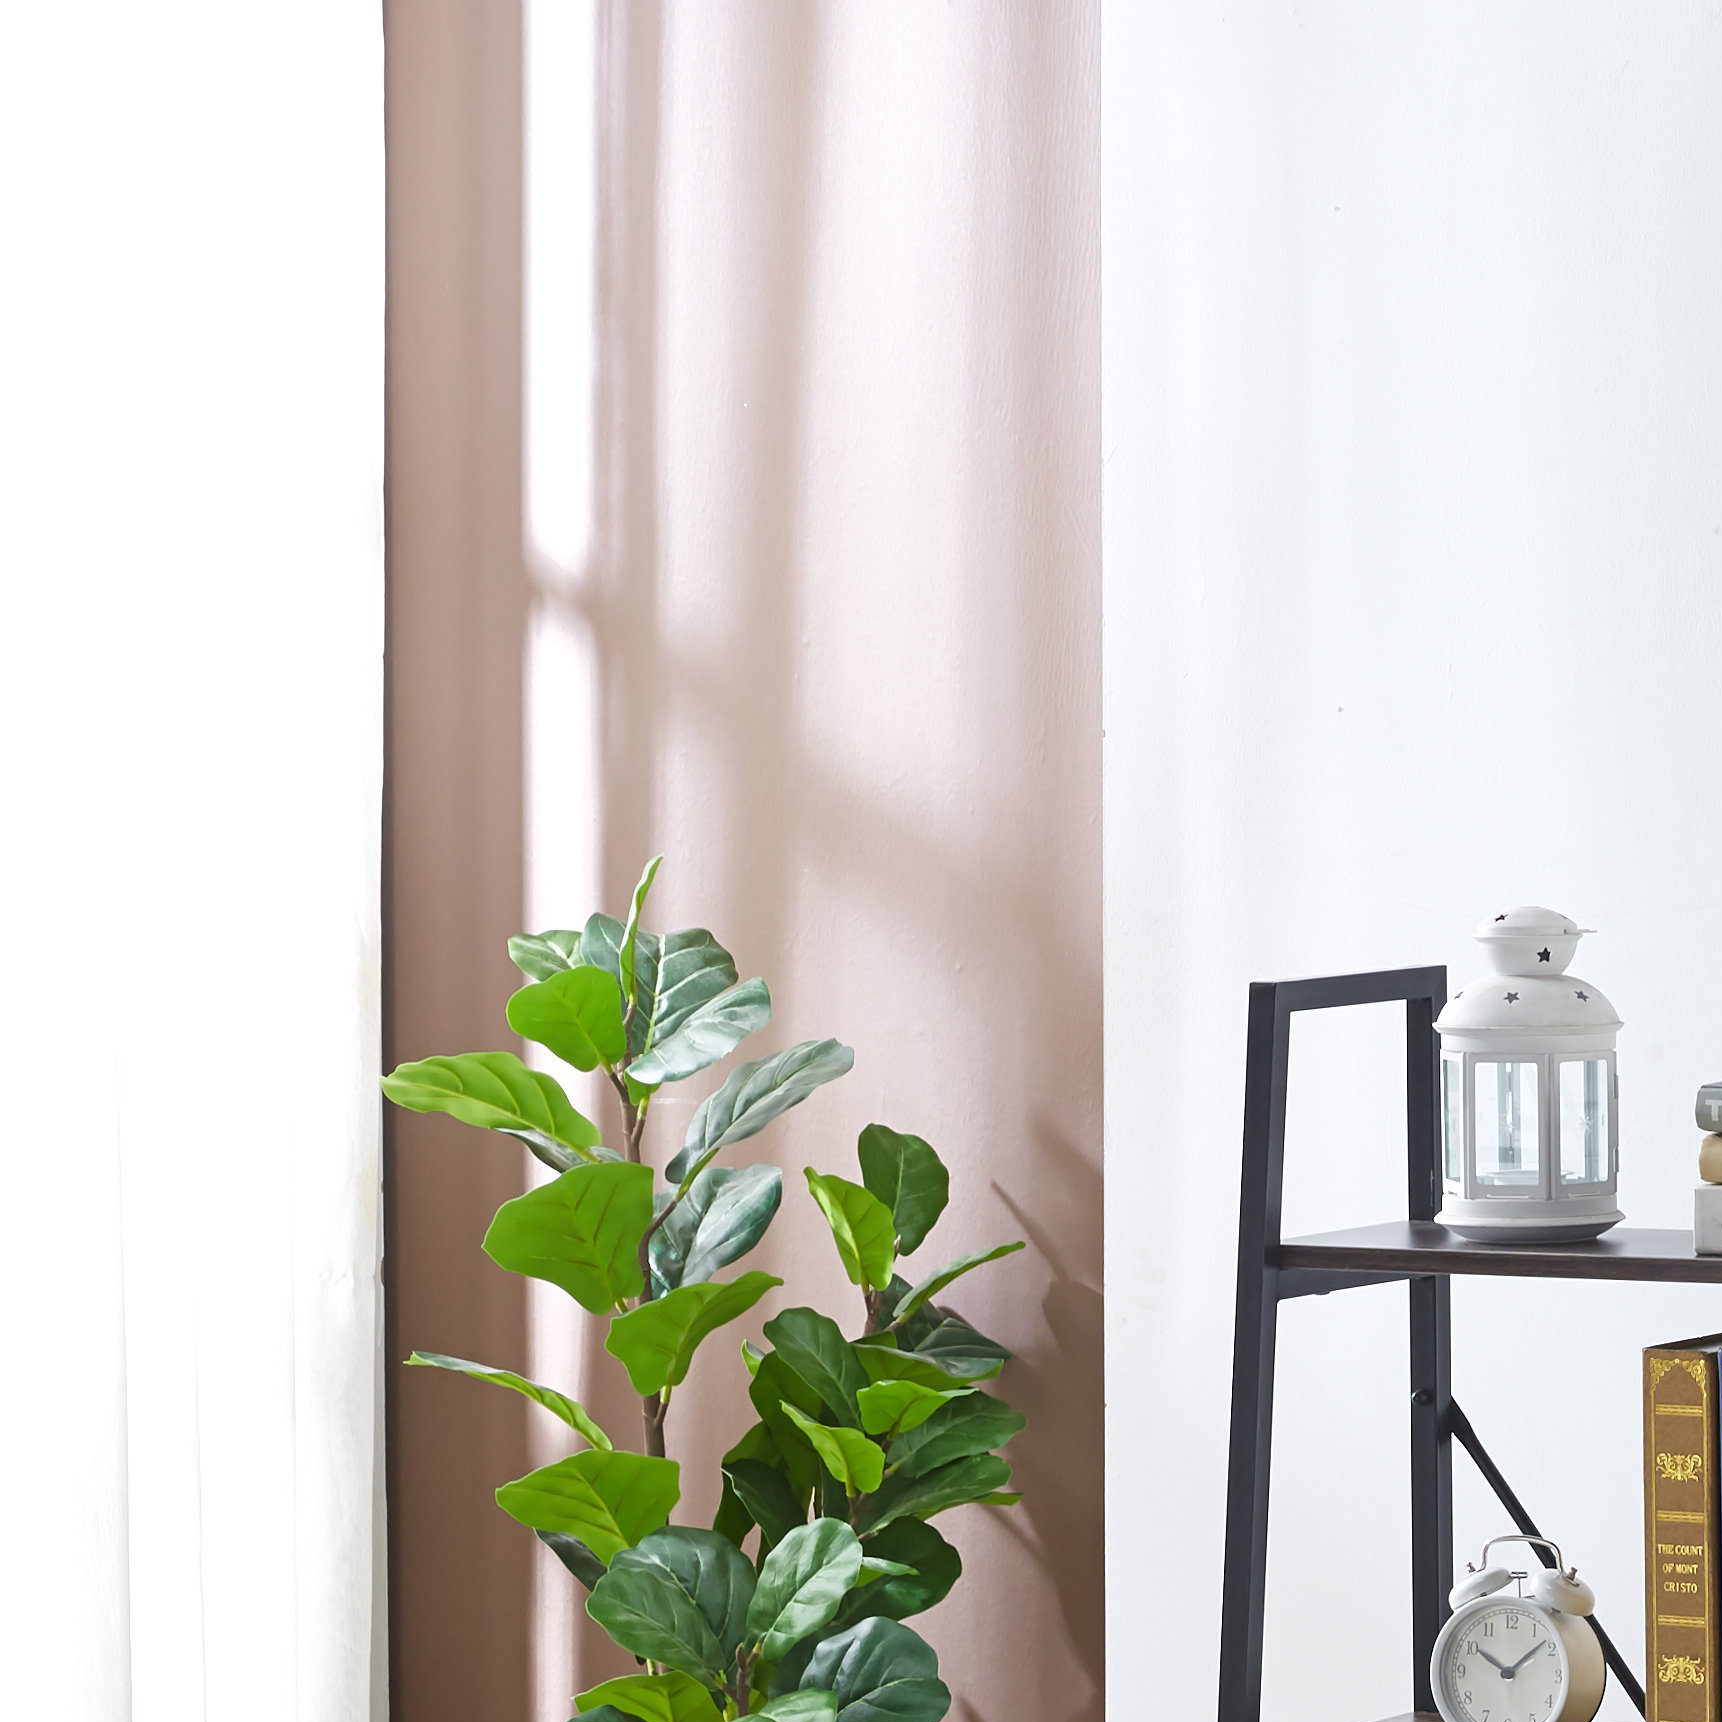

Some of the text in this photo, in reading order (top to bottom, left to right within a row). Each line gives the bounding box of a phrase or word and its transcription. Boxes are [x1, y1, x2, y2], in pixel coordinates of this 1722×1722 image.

[1657, 1543, 1703, 1556] THE COUNT
[1662, 1563, 1699, 1575] OF MONT
[1663, 1581, 1698, 1593] CRISTO
[1506, 1615, 1519, 1629] 12
[1484, 1622, 1494, 1637] 11
[1531, 1623, 1537, 1637] 1
[1466, 1641, 1479, 1655] 10
[1548, 1643, 1556, 1656] 2
[1457, 1664, 1466, 1678] 9
[1554, 1669, 1562, 1684] 3
[1464, 1691, 1472, 1705] 8
[1545, 1694, 1553, 1708] 4
